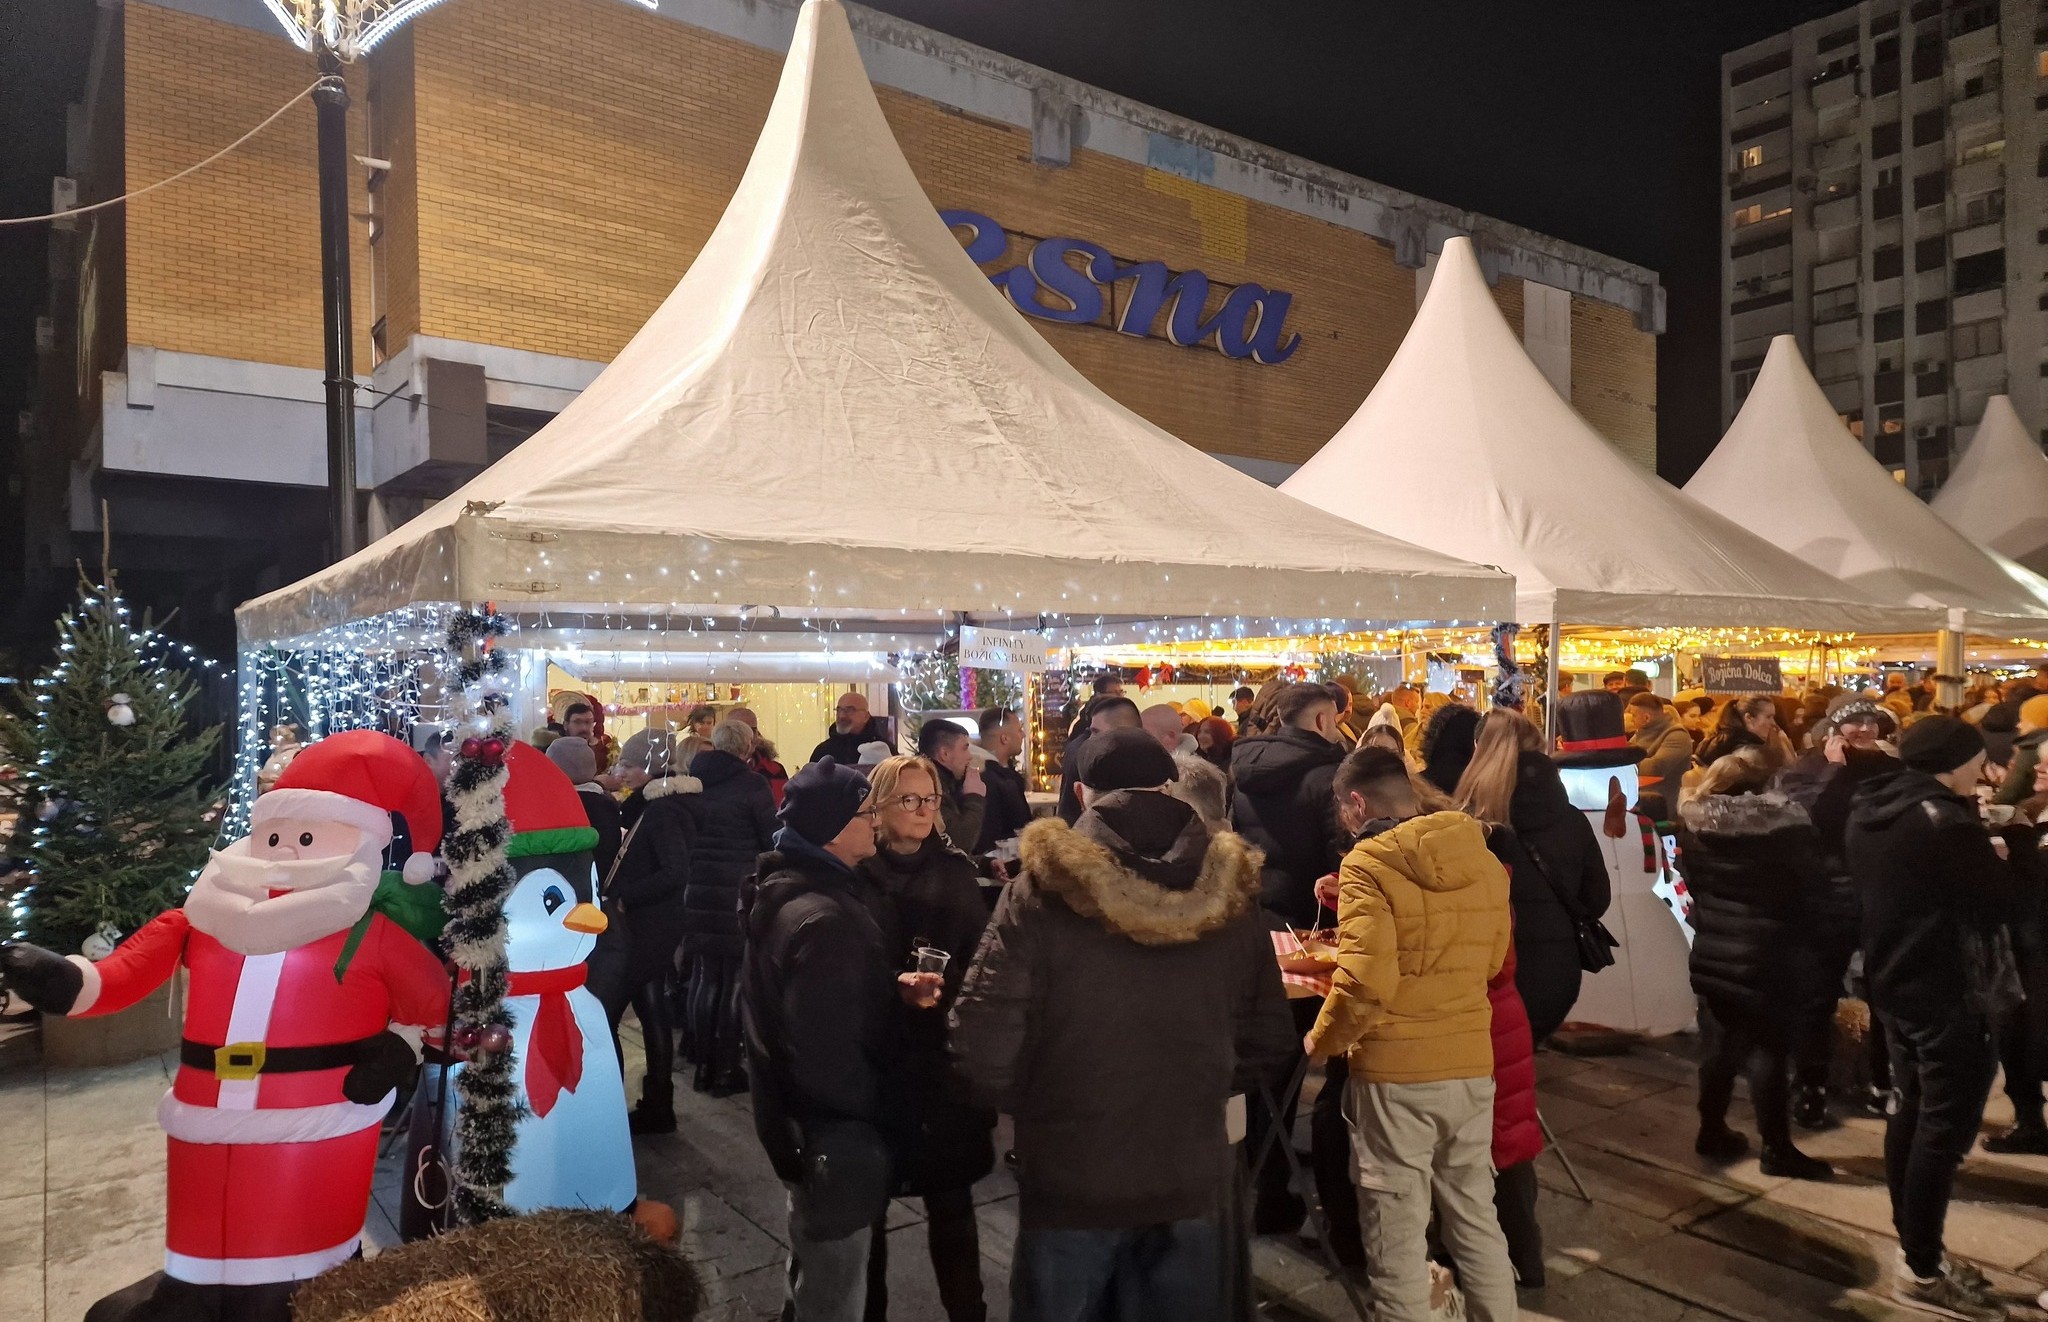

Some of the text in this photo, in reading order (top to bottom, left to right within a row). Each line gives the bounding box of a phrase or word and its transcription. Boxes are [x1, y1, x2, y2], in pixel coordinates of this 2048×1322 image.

[982, 635, 1026, 649] INFINITY
[1011, 652, 1042, 665] BAJKA
[1743, 662, 1773, 685] Dolca
